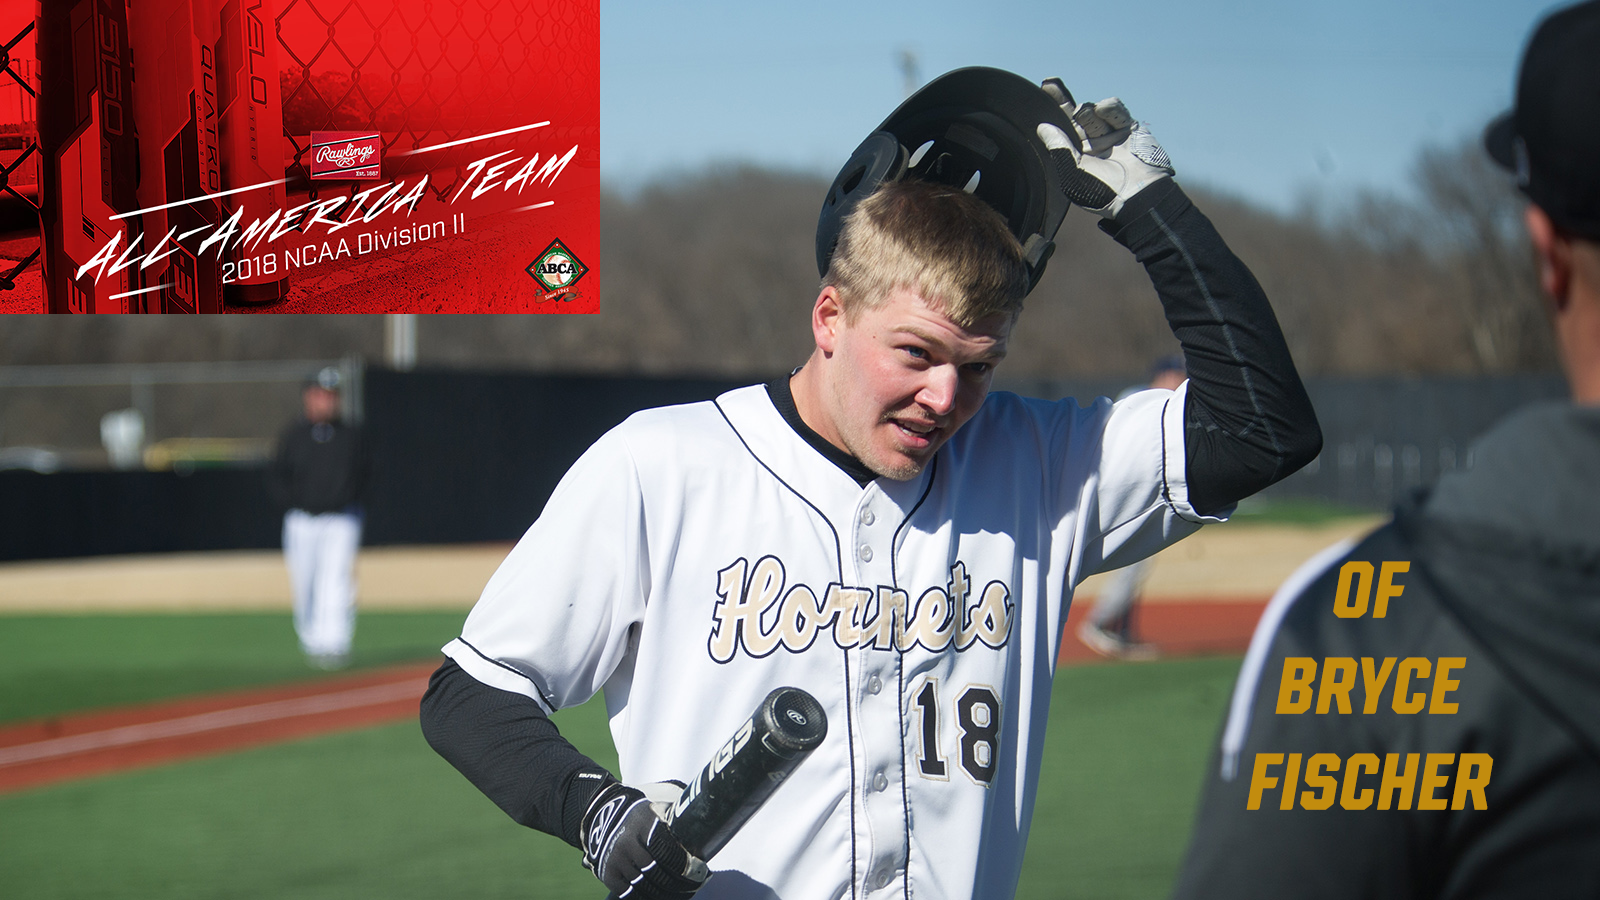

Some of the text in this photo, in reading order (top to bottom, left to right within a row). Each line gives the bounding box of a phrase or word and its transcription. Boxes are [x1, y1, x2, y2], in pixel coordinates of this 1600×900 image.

[99, 13, 123, 136] 5150
[201, 44, 219, 192] QUATRO
[102, 144, 110, 199] ALLOY
[196, 94, 207, 187] COMPOSITE
[249, 105, 257, 161] HYBRID
[707, 554, 1015, 664] Hornets
[912, 676, 1002, 789] 18
